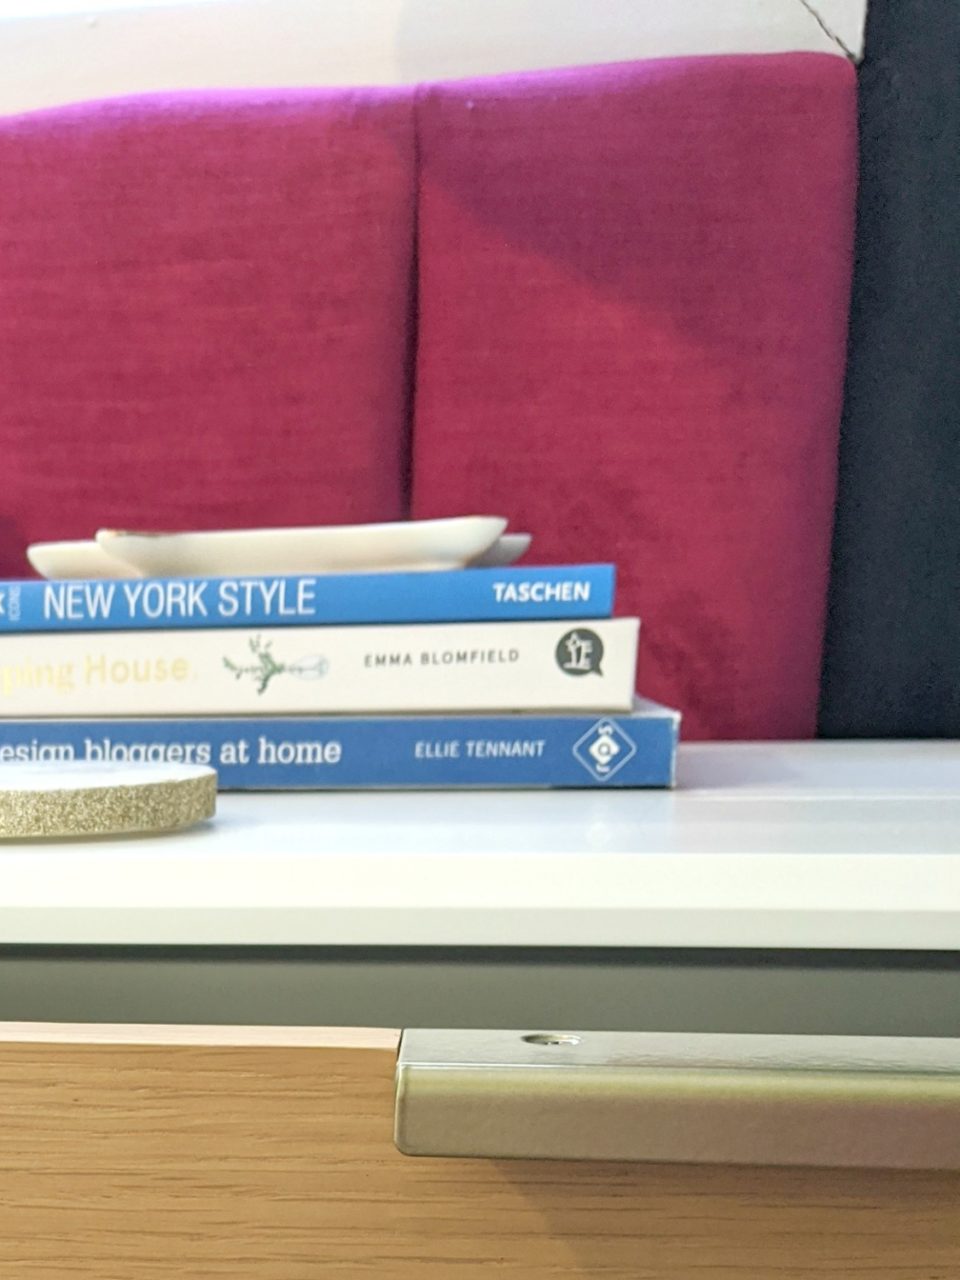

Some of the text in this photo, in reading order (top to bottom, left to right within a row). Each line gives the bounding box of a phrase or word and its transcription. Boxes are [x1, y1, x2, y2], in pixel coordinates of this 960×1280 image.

[43, 578, 317, 620] NEW YORK STYLE
[493, 581, 591, 603] TASCHEN
[363, 648, 520, 668] EMMA BLOMFIELD
[220, 740, 248, 765] at
[257, 736, 342, 765] home
[414, 739, 546, 759] ELLIE TENNANT
